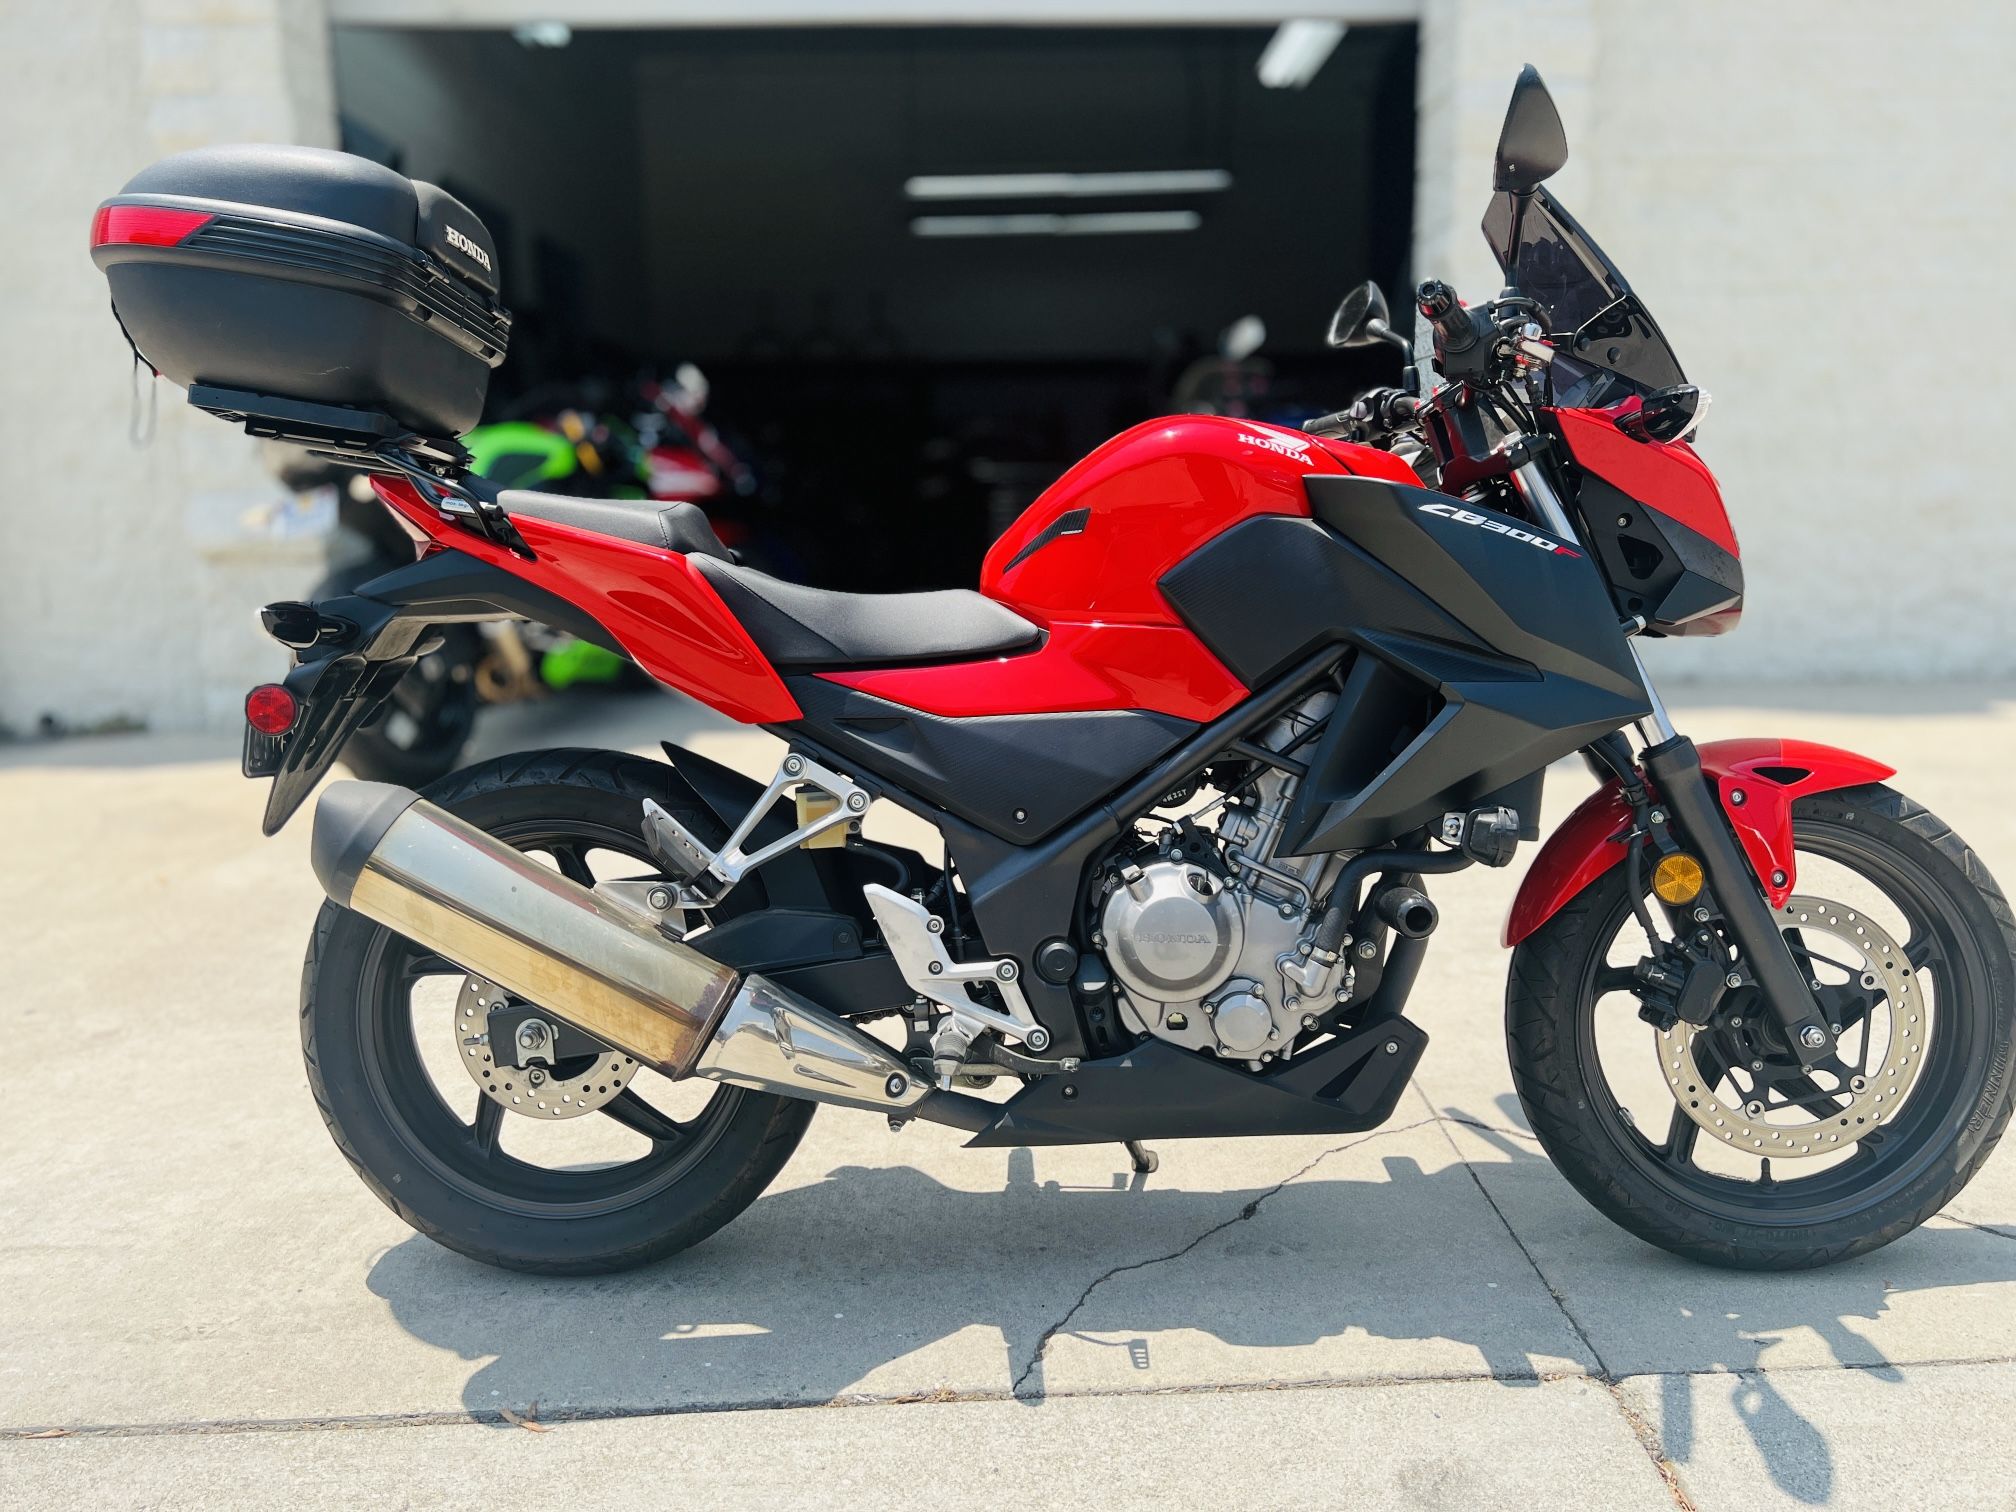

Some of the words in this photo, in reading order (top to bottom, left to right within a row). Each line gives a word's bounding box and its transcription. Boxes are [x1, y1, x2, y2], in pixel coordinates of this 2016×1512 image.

[445, 224, 492, 272] HONDA
[1237, 433, 1315, 467] HONDA
[1418, 503, 1583, 559] CB300F
[1137, 931, 1212, 944] HONDA
